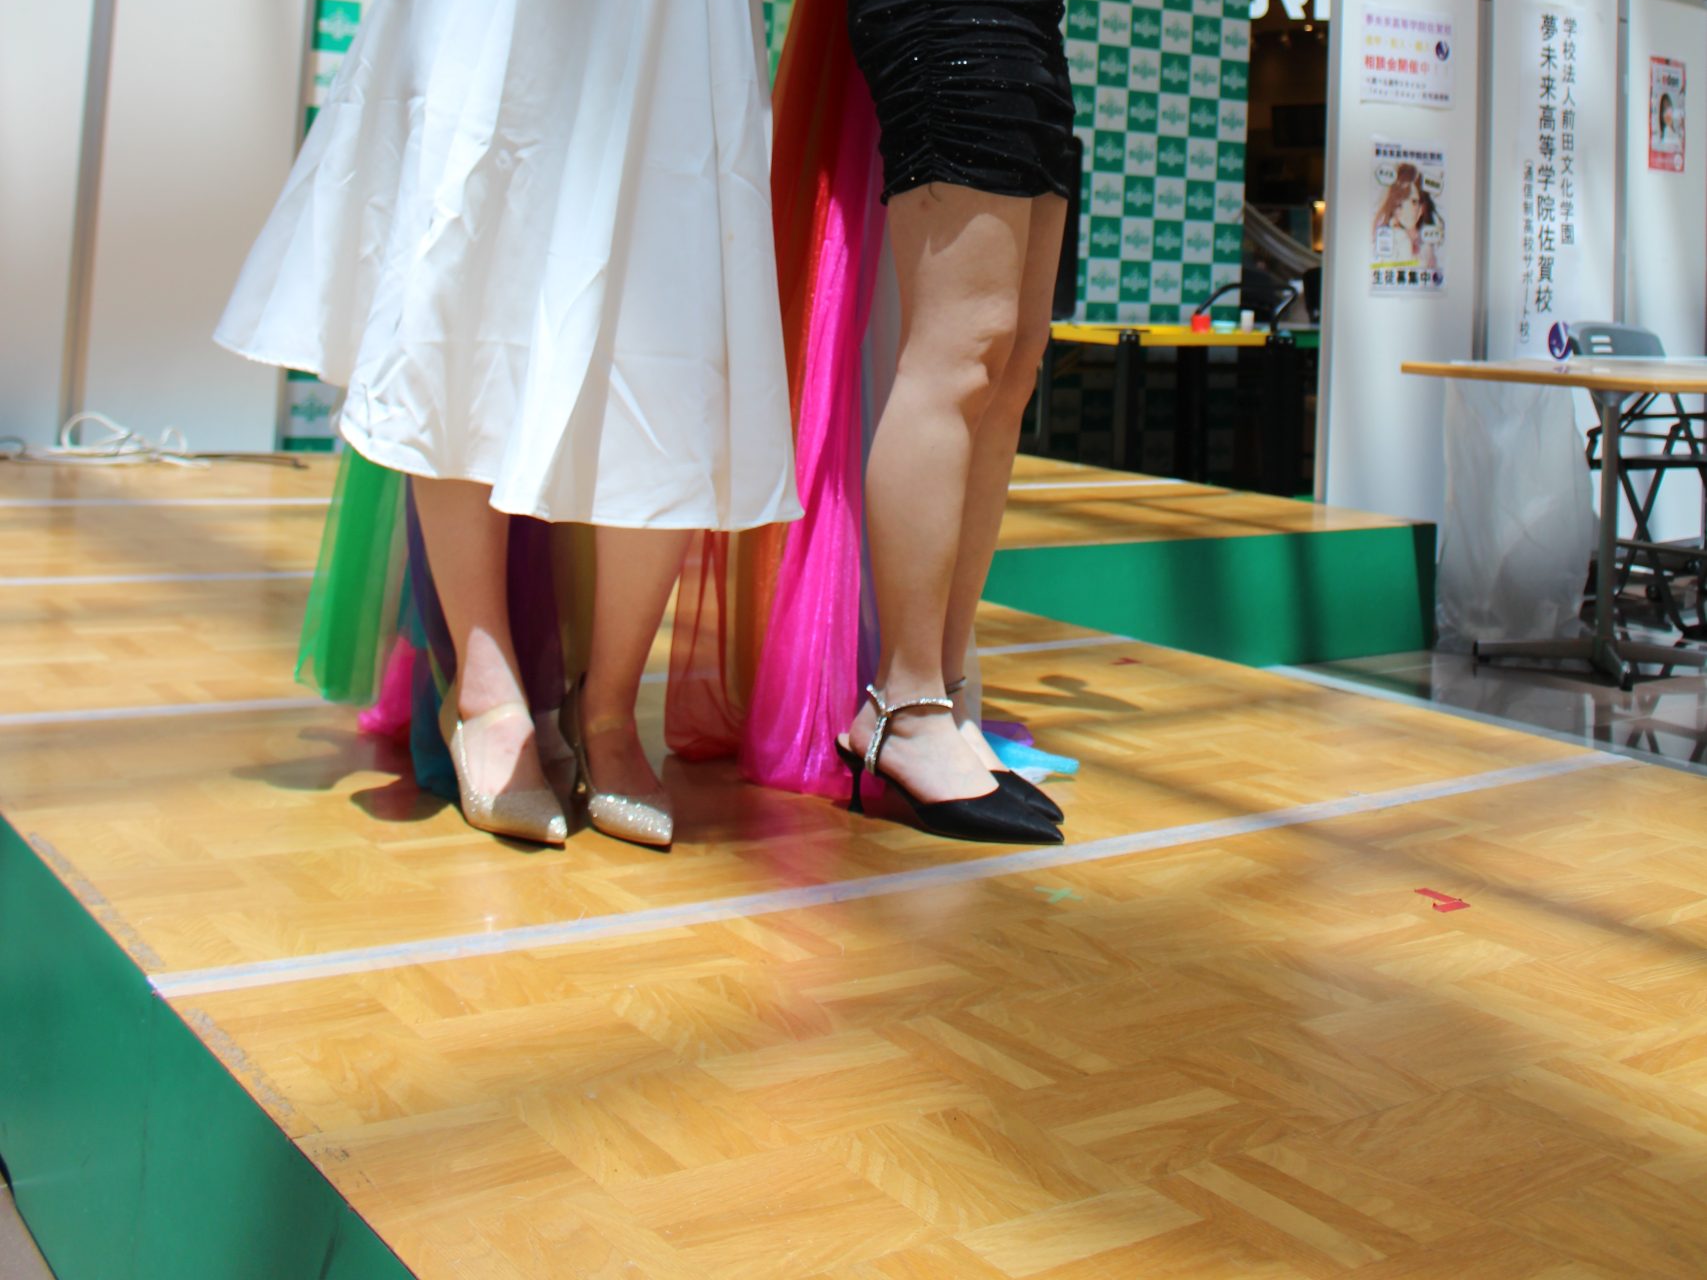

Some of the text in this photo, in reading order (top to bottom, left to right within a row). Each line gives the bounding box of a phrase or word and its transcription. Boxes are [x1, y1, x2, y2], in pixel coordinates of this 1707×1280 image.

[1535, 13, 1558, 314] 夢未来高等学院佐賀校
[1559, 16, 1577, 246] 学校法人前田文化学園
[1372, 270, 1432, 287] 生徒募集中
